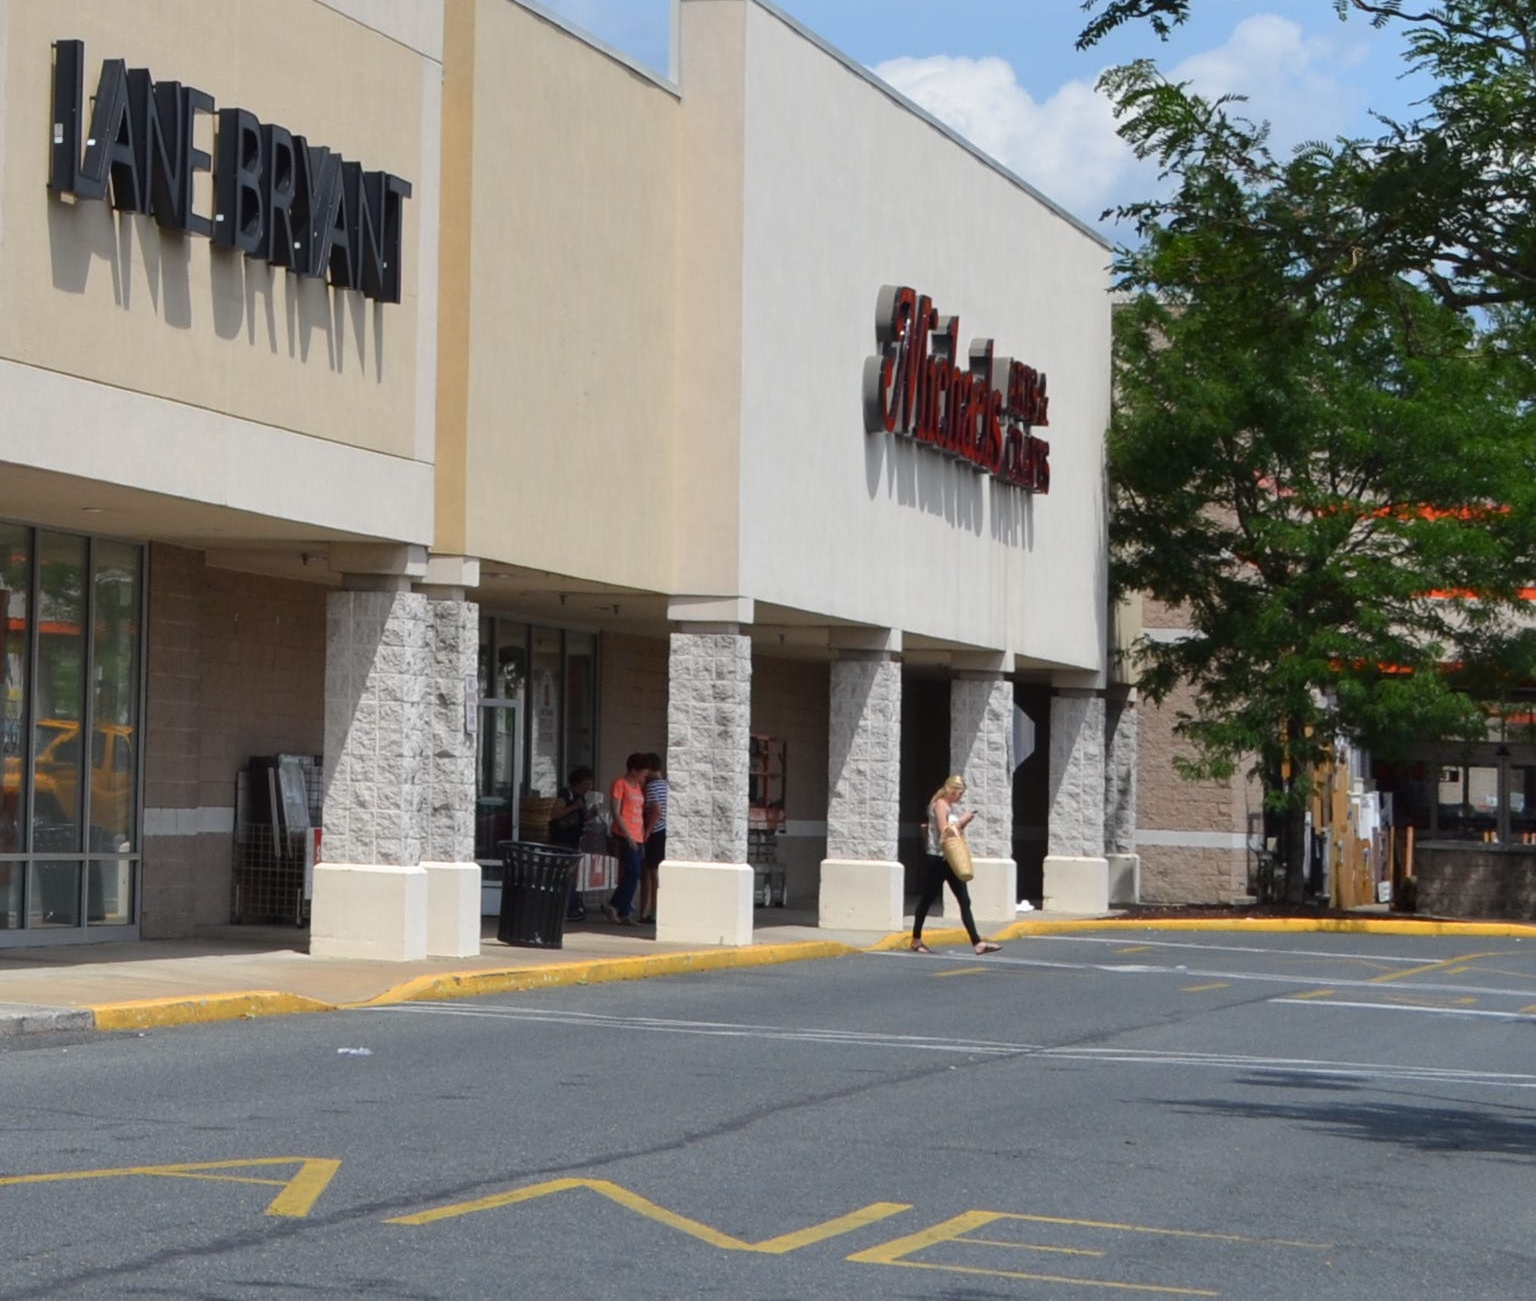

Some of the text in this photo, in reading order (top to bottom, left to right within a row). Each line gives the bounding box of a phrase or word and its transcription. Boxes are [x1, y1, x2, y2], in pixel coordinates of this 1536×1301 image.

[47, 39, 412, 305] LANE BRYANT
[864, 284, 1004, 475] Michaels
